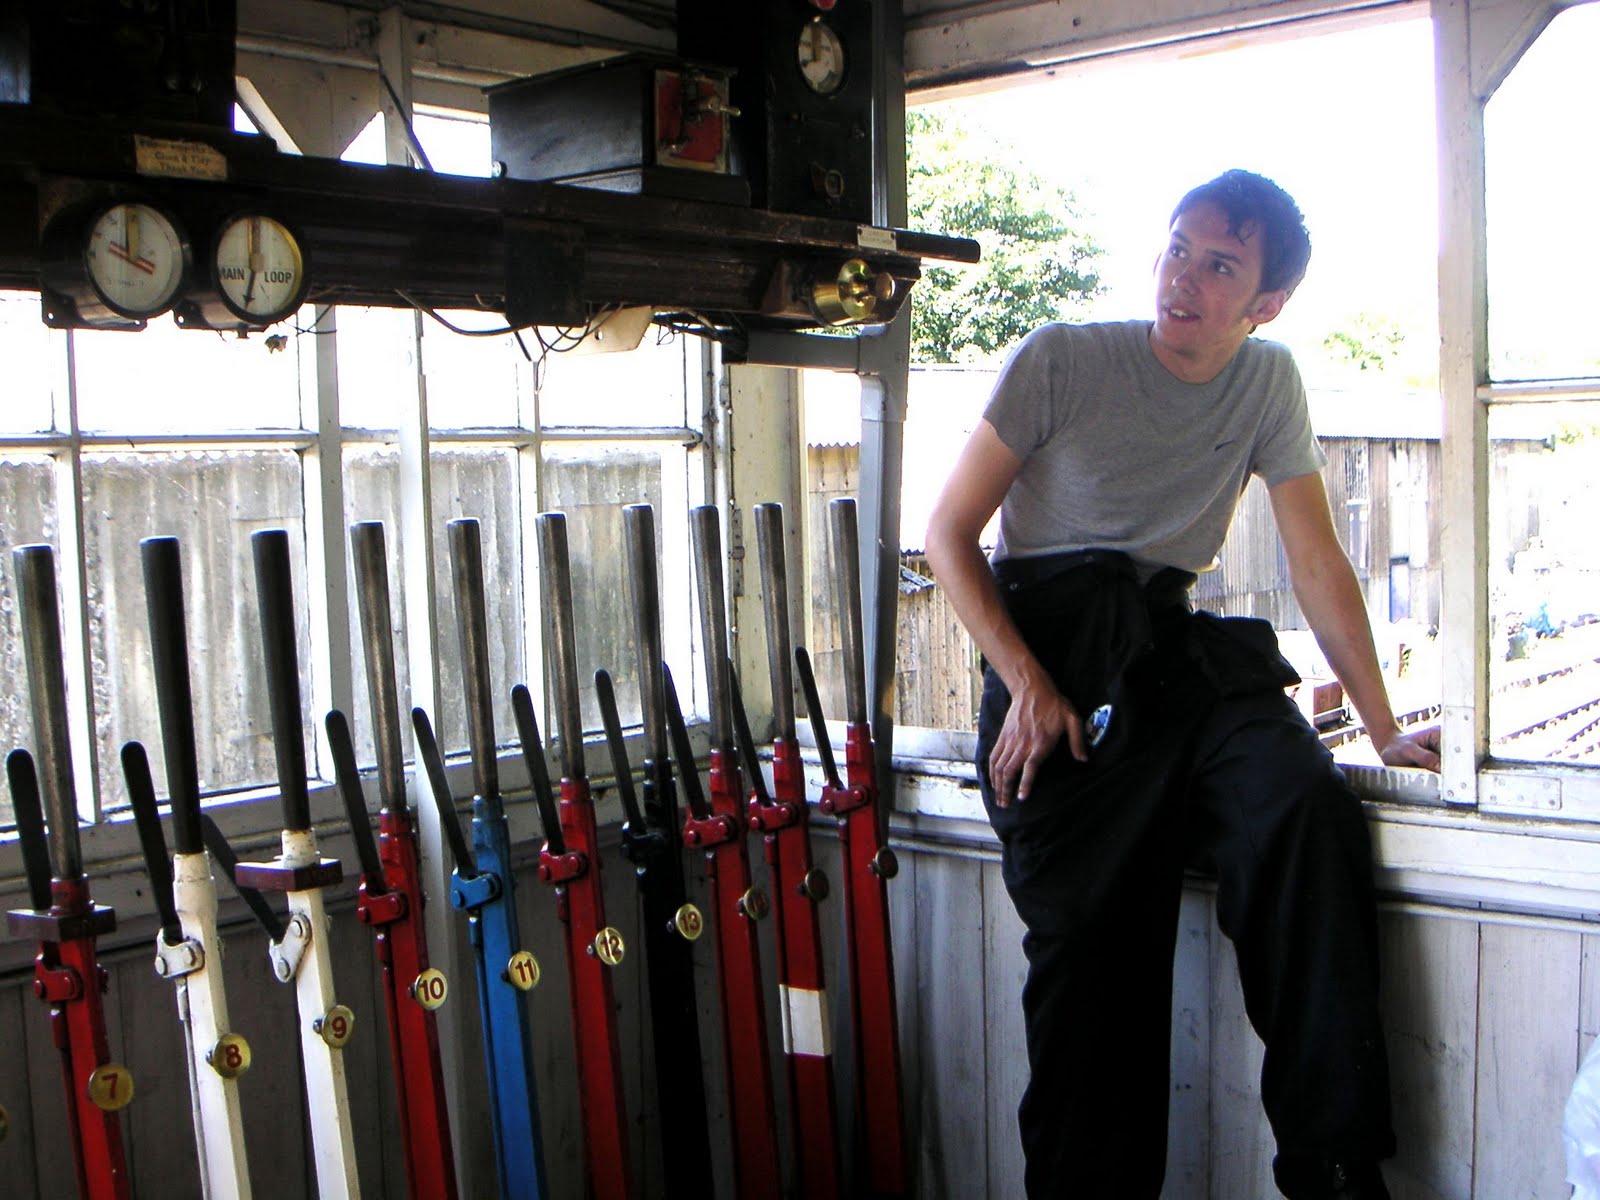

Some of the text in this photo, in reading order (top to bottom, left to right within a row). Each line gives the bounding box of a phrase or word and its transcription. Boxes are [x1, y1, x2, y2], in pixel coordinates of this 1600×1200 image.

[264, 270, 292, 284] LOOP
[681, 911, 700, 932] 13
[601, 935, 622, 958] 12
[515, 959, 535, 983] 11
[420, 977, 444, 1002] 10
[331, 1016, 347, 1039] 9
[225, 1044, 242, 1068] 8
[102, 1072, 118, 1100] 7
